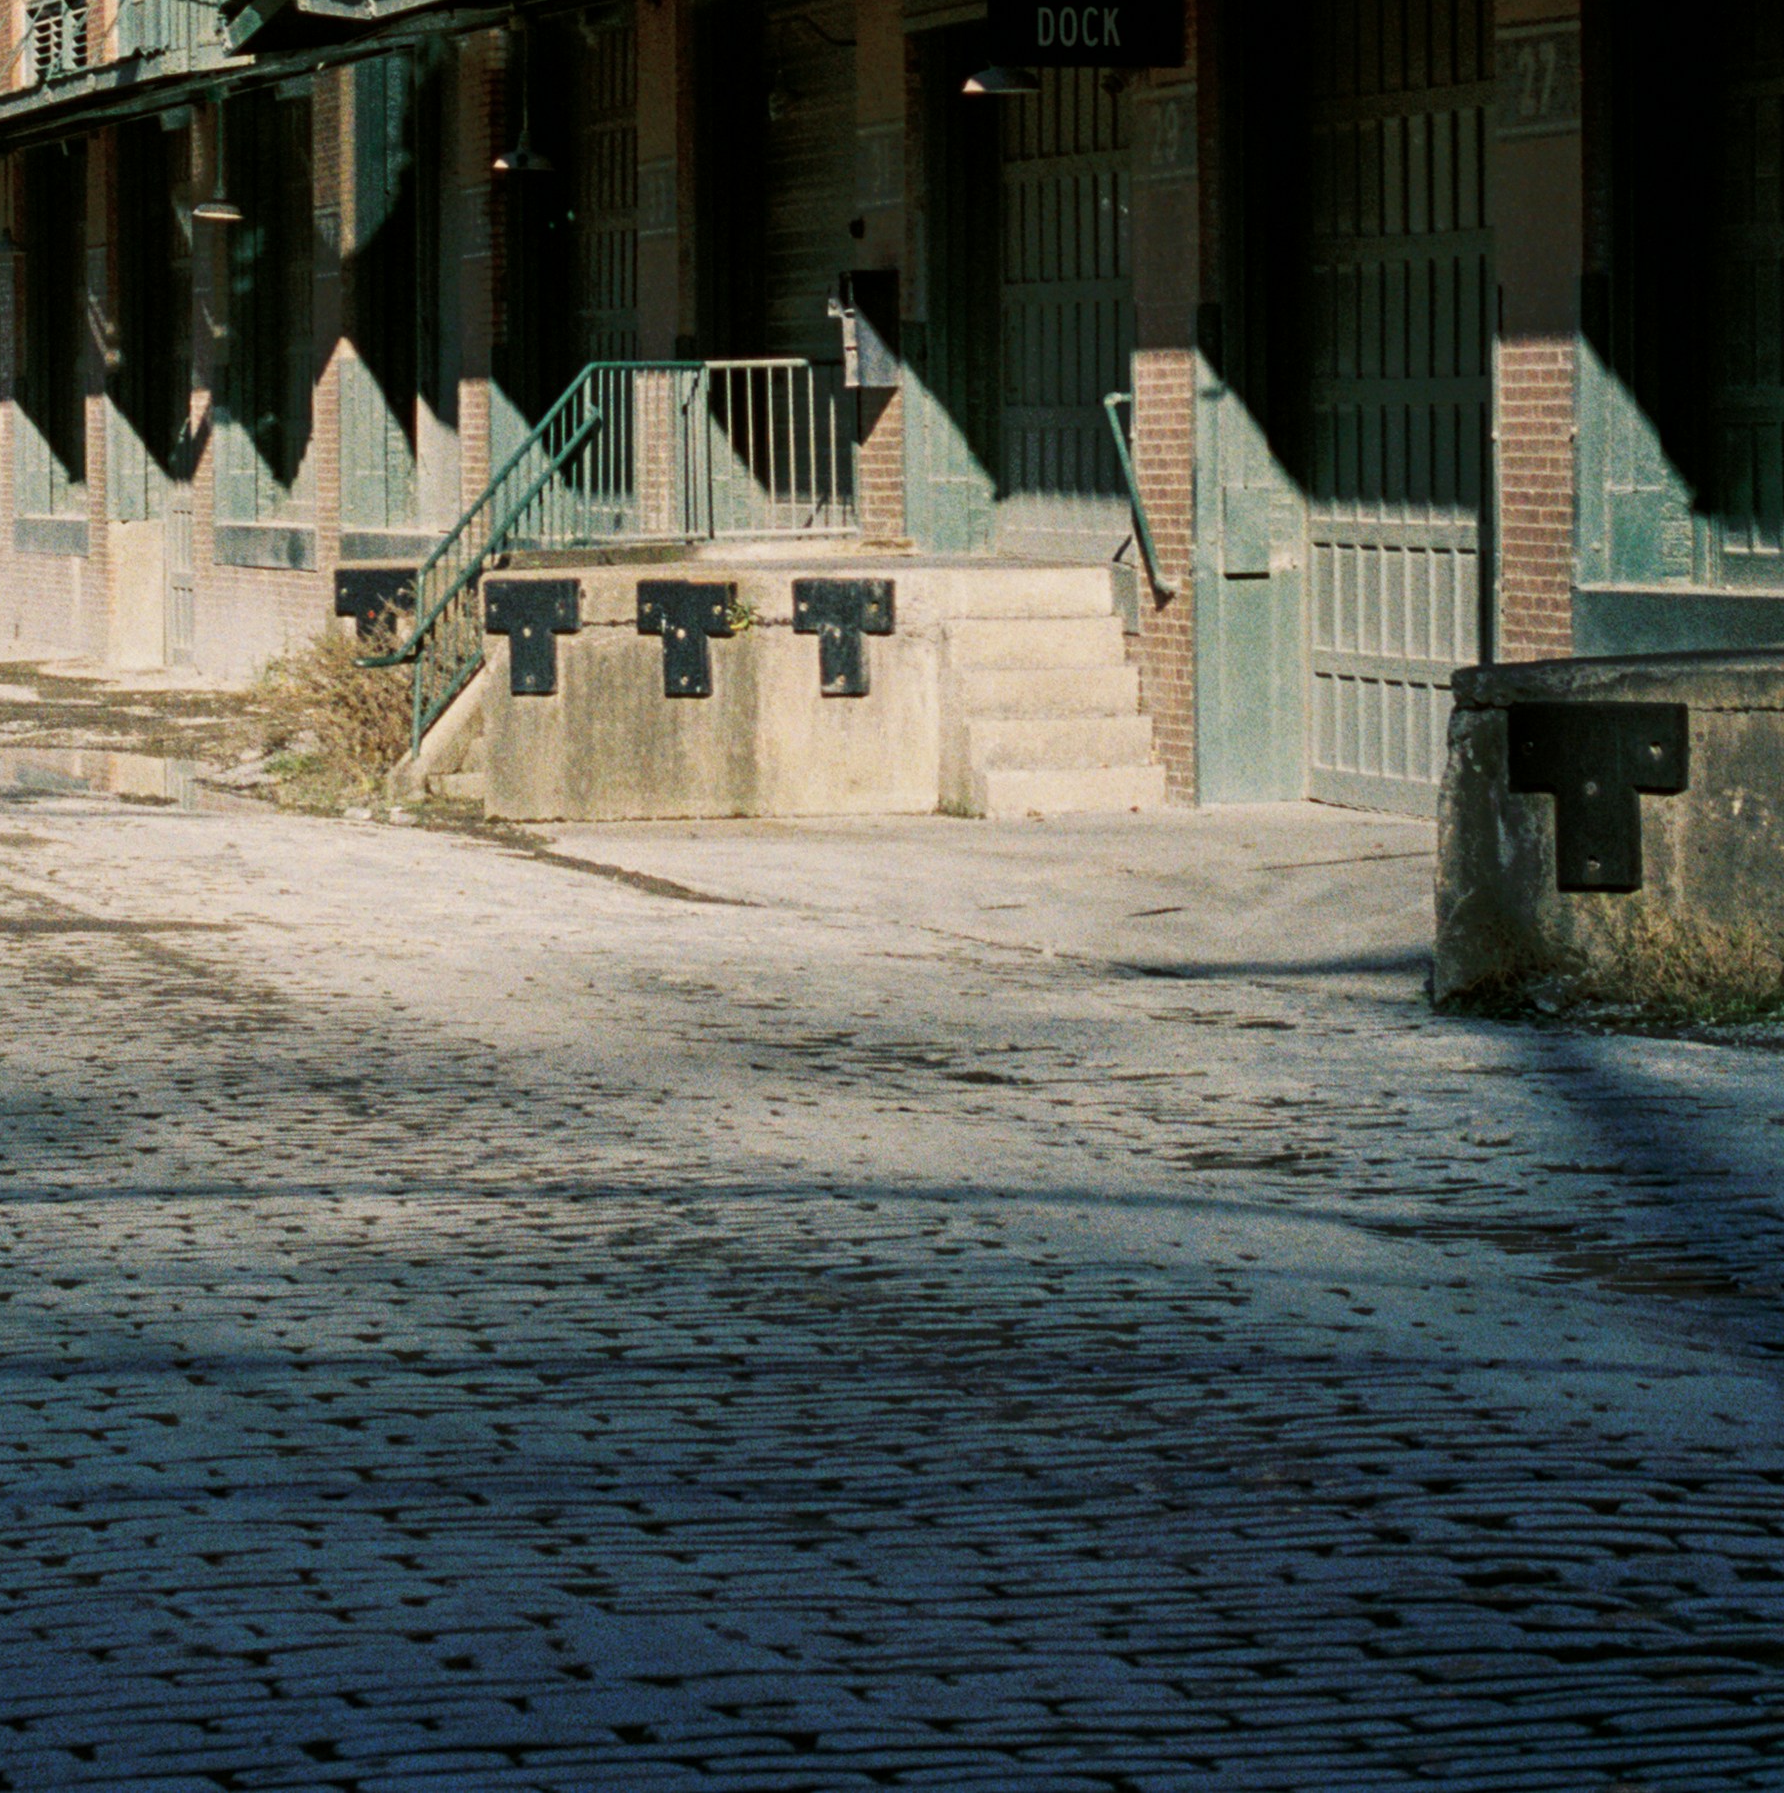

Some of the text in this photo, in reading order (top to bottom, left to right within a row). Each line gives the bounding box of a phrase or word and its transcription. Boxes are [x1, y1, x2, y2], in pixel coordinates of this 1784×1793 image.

[1037, 6, 1122, 48] DOCK
[1518, 42, 1556, 116] 27
[1150, 101, 1180, 166] 29
